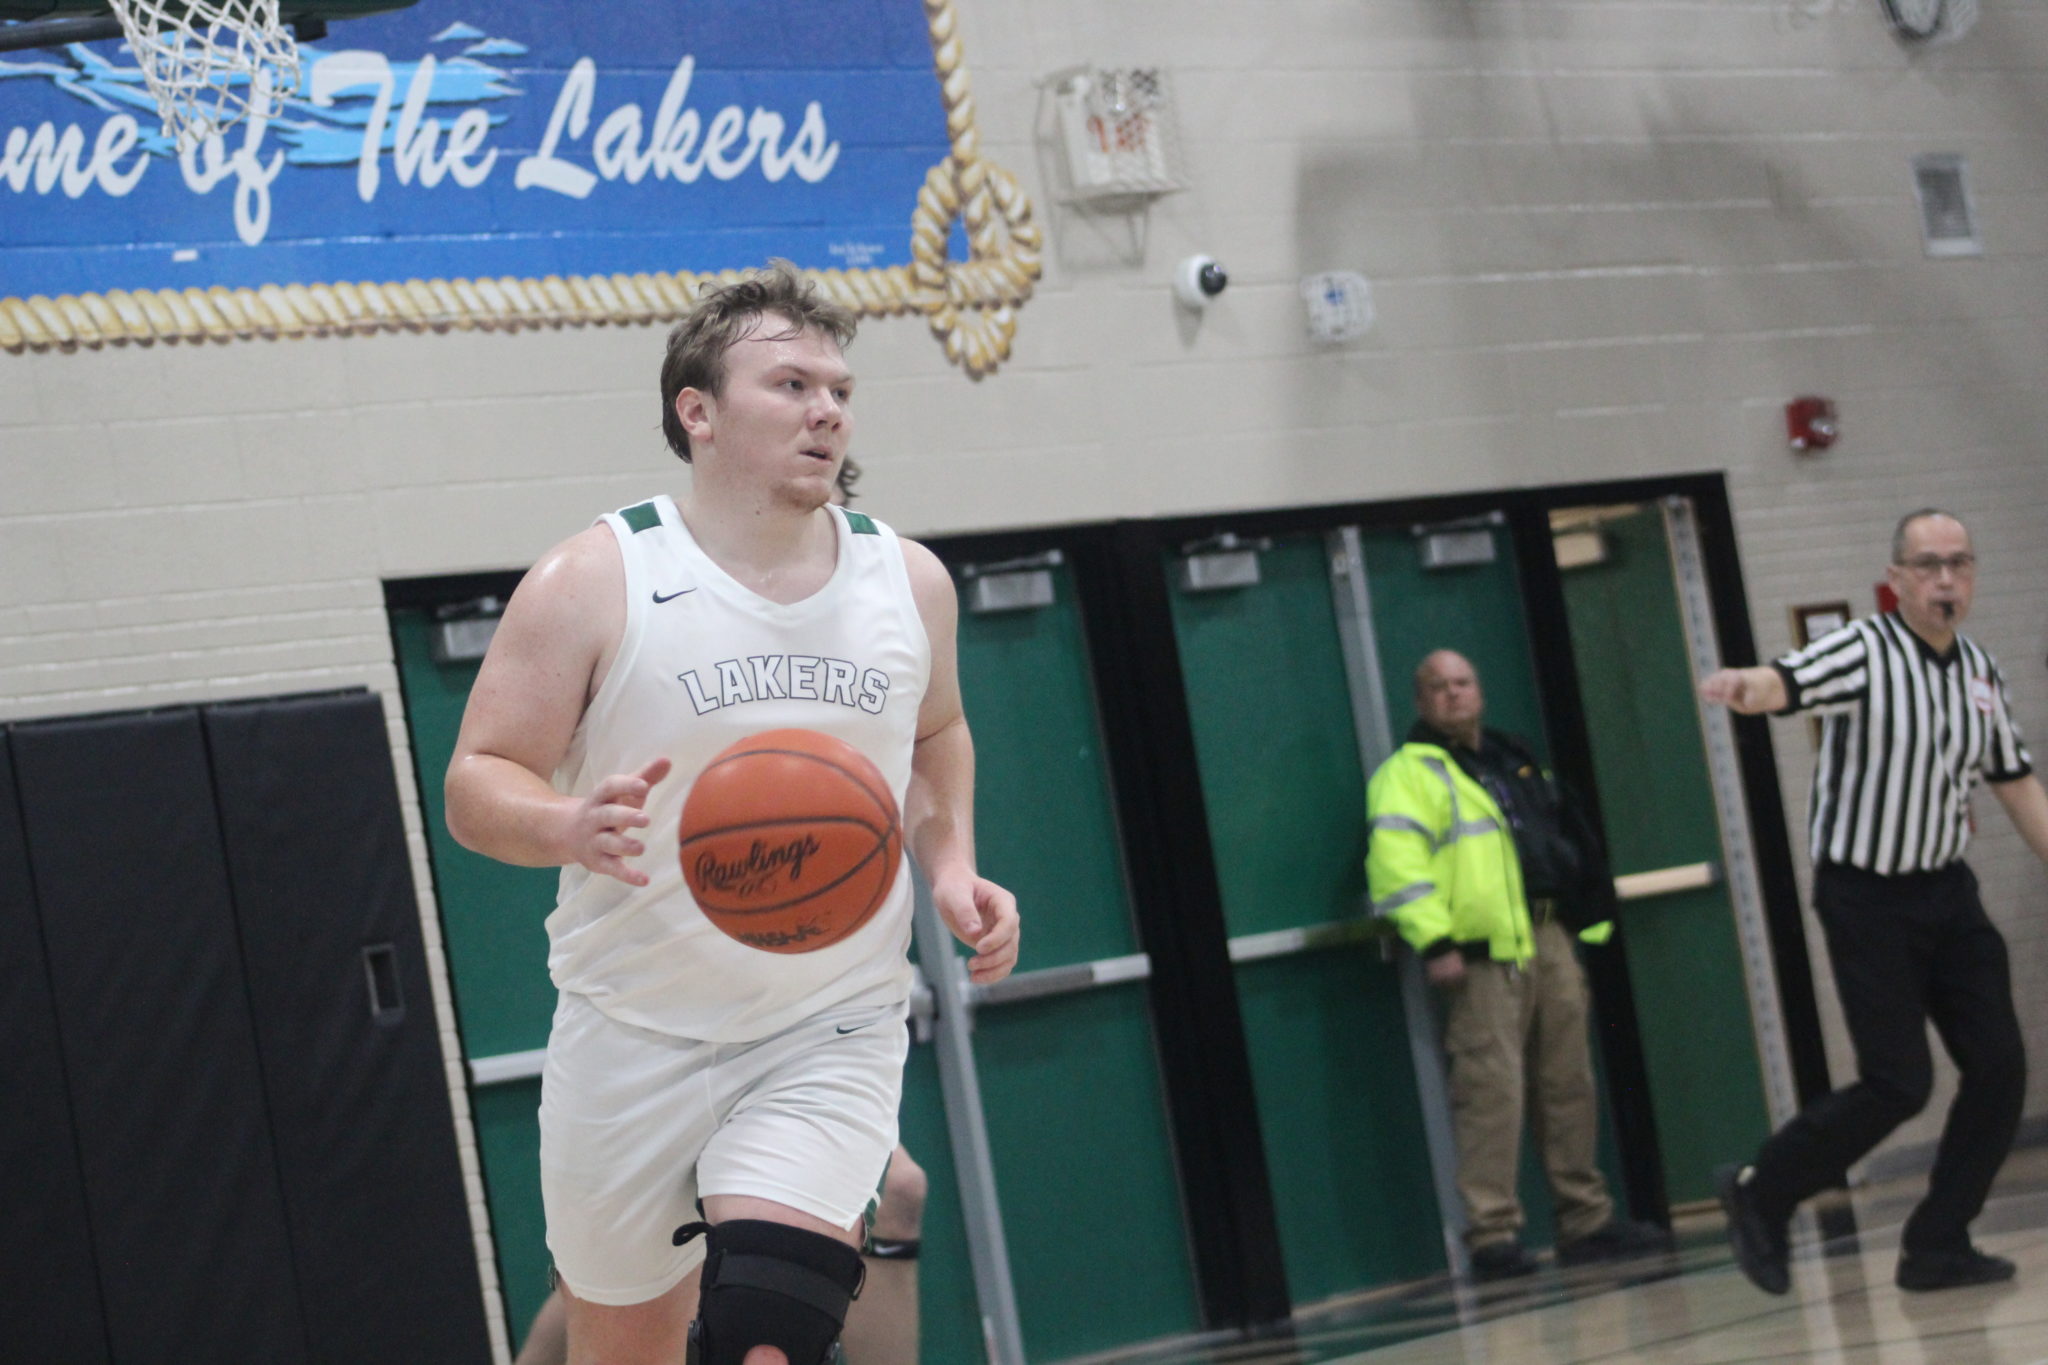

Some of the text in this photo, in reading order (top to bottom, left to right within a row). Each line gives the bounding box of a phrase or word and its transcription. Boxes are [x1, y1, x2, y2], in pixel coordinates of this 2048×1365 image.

[178, 66, 285, 246] of
[311, 50, 498, 202] The
[515, 54, 840, 199] Lakers
[677, 654, 891, 716] LAKERS
[695, 833, 822, 893] Rawlings
